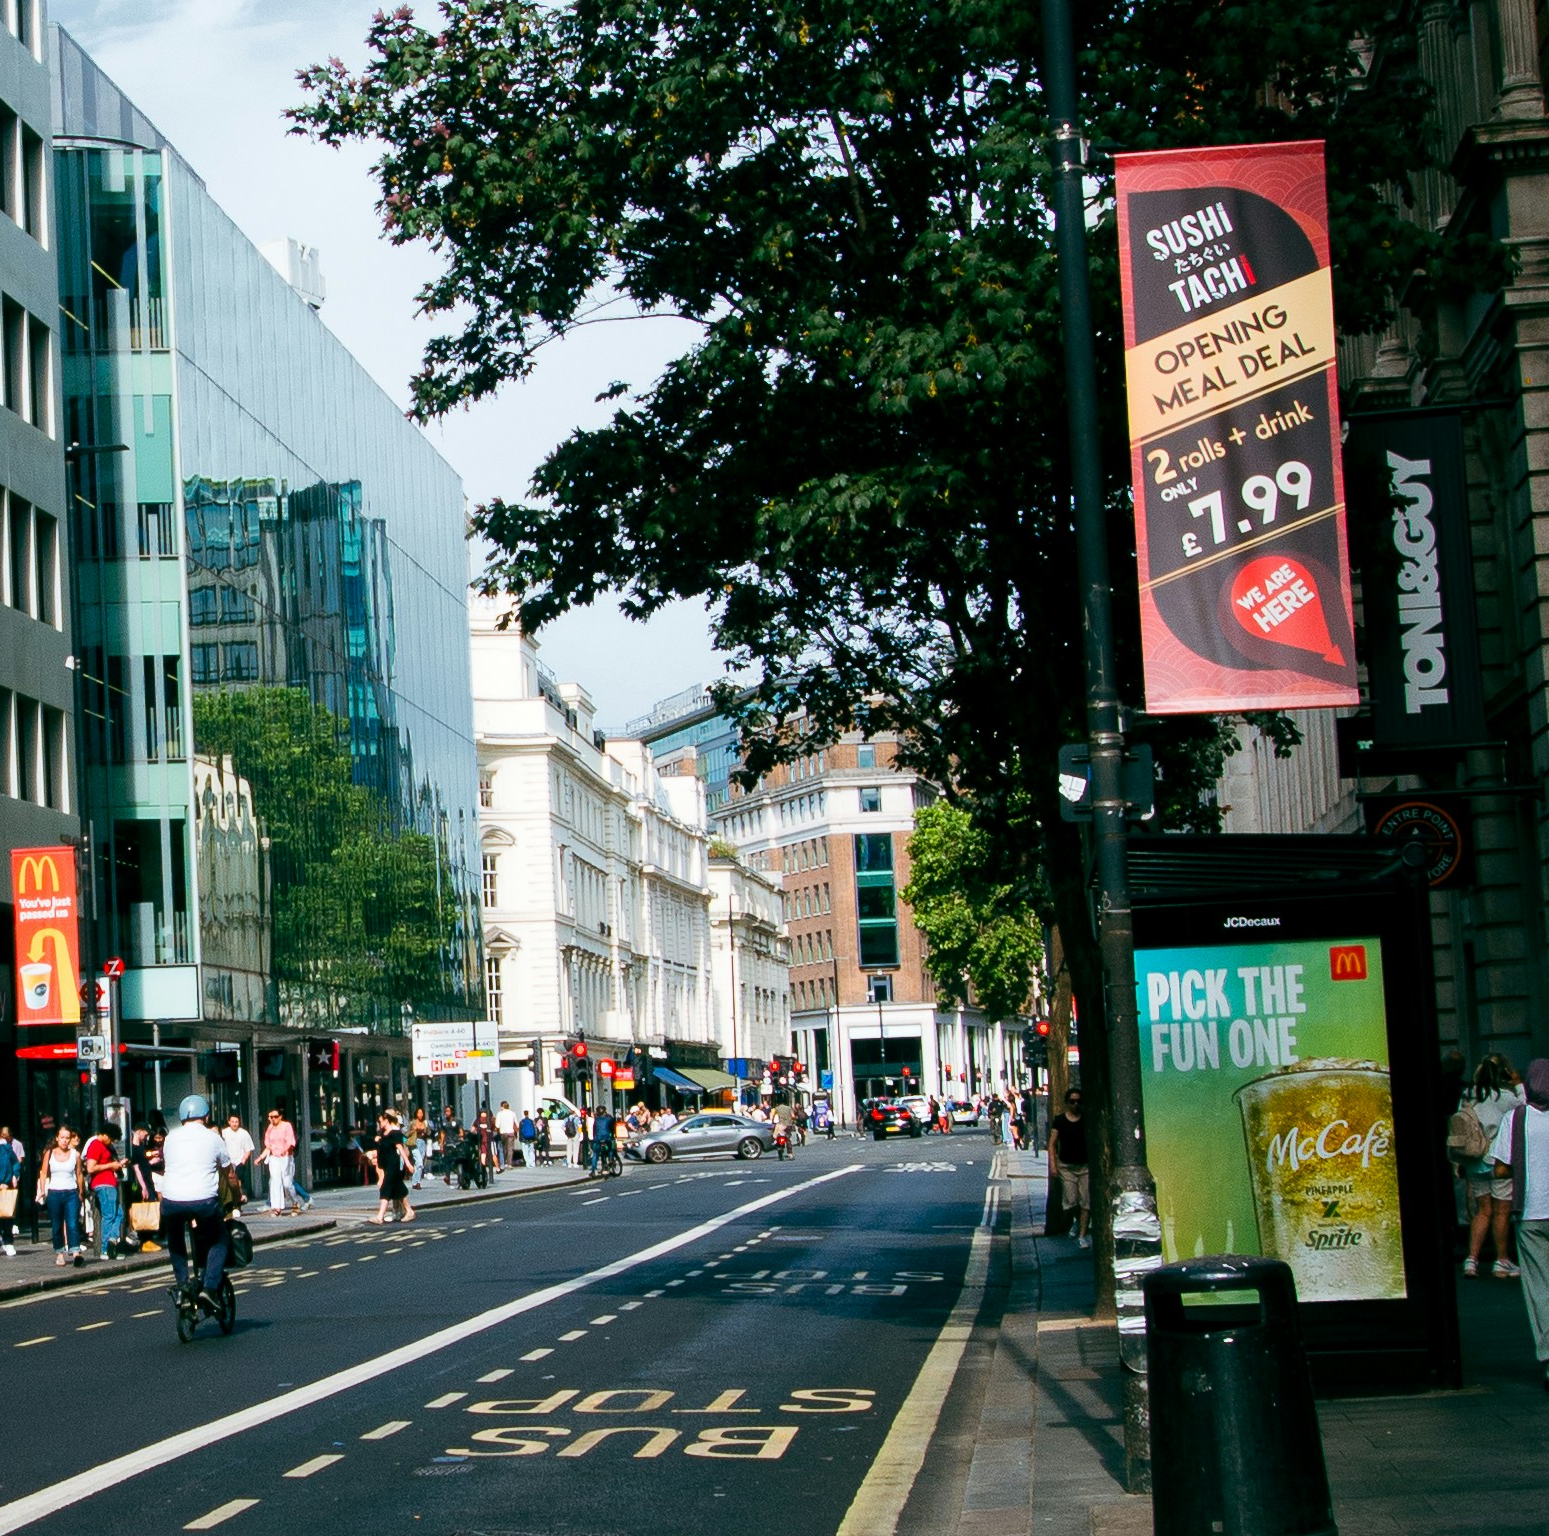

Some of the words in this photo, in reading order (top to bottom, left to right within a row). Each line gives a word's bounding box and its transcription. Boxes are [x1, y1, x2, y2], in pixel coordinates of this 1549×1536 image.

[1174, 242, 1231, 275] たちぐい
[1154, 304, 1287, 374] OPENING
[1152, 366, 1236, 415] MEAL
[1238, 333, 1316, 379] DEAL
[1147, 449, 1177, 485] 2
[1179, 437, 1226, 472] rolls
[1256, 400, 1314, 440] drink
[1160, 477, 1198, 502] ONLY
[1237, 586, 1266, 610] WE
[1265, 563, 1296, 596] ARE
[1386, 450, 1448, 714] TONI&GUY
[1252, 579, 1315, 633] HERE
[1381, 808, 1419, 835] ENTRE
[1423, 809, 1454, 839] POINT
[1427, 853, 1453, 880] TORE
[19, 897, 51, 909] You've
[51, 896, 71, 910] just
[20, 908, 56, 922] passed
[56, 909, 68, 918] us
[1223, 916, 1281, 928] JCDecaux
[107, 960, 121, 975] Z
[1147, 968, 1231, 1021] PICK
[1238, 965, 1306, 1016] THE
[1152, 1020, 1220, 1073] FUN
[1228, 1017, 1299, 1069] ONE
[1266, 1119, 1390, 1173] McCafé
[1306, 1184, 1354, 1196] PINEAPPLE
[1305, 1229, 1363, 1251] Sprite
[720, 1282, 908, 1296] BUS
[463, 1388, 877, 1414] STOP
[445, 1426, 799, 1459] BUS
